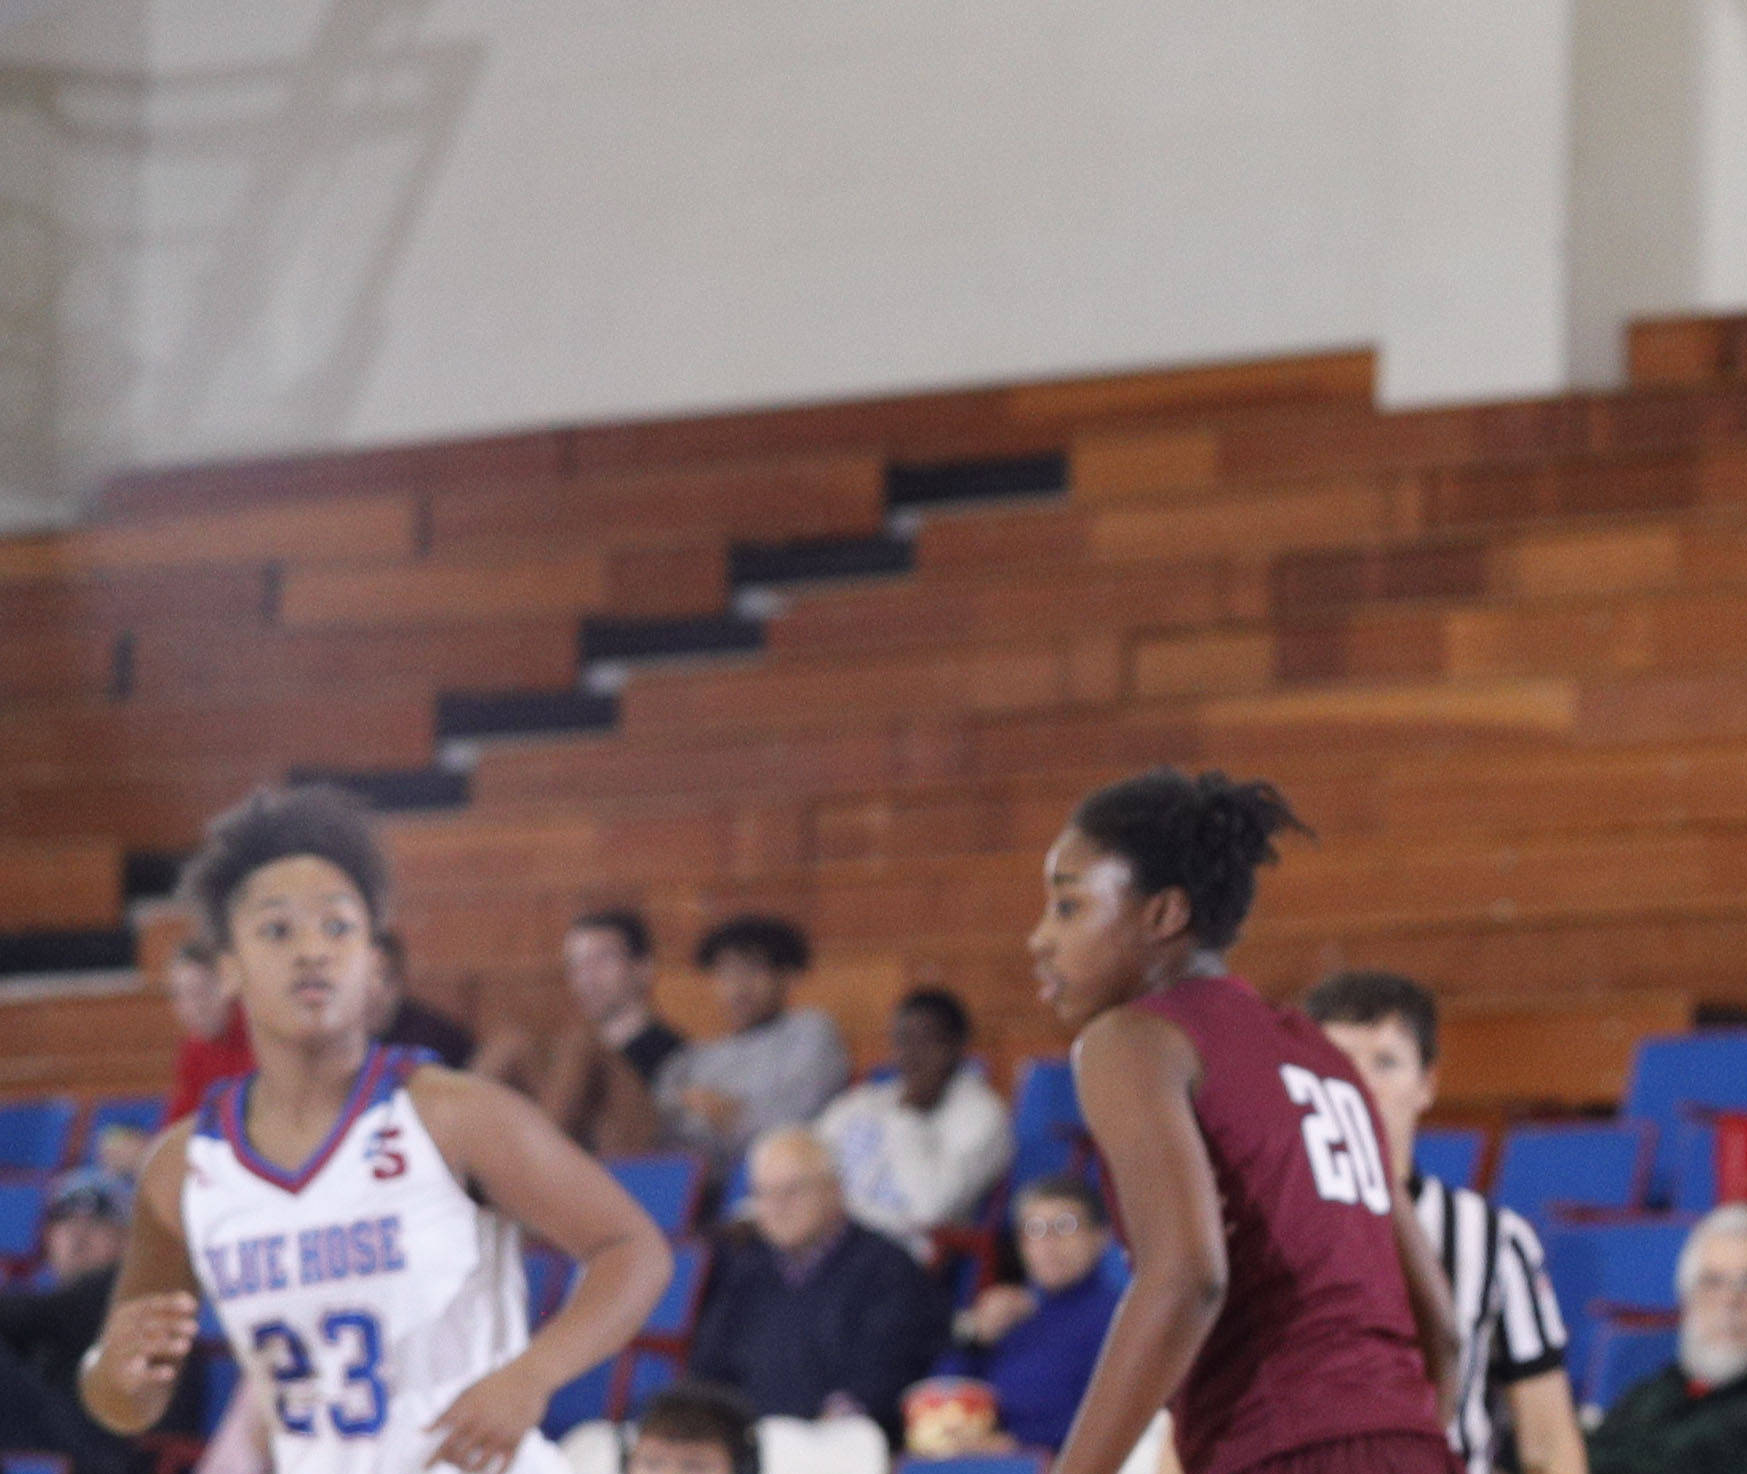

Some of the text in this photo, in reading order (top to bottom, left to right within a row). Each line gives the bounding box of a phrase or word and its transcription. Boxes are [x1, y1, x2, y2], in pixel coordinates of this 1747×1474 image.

[1279, 1062, 1391, 1216] 20
[298, 1216, 406, 1286] HOSE
[253, 1308, 388, 1438] 23
